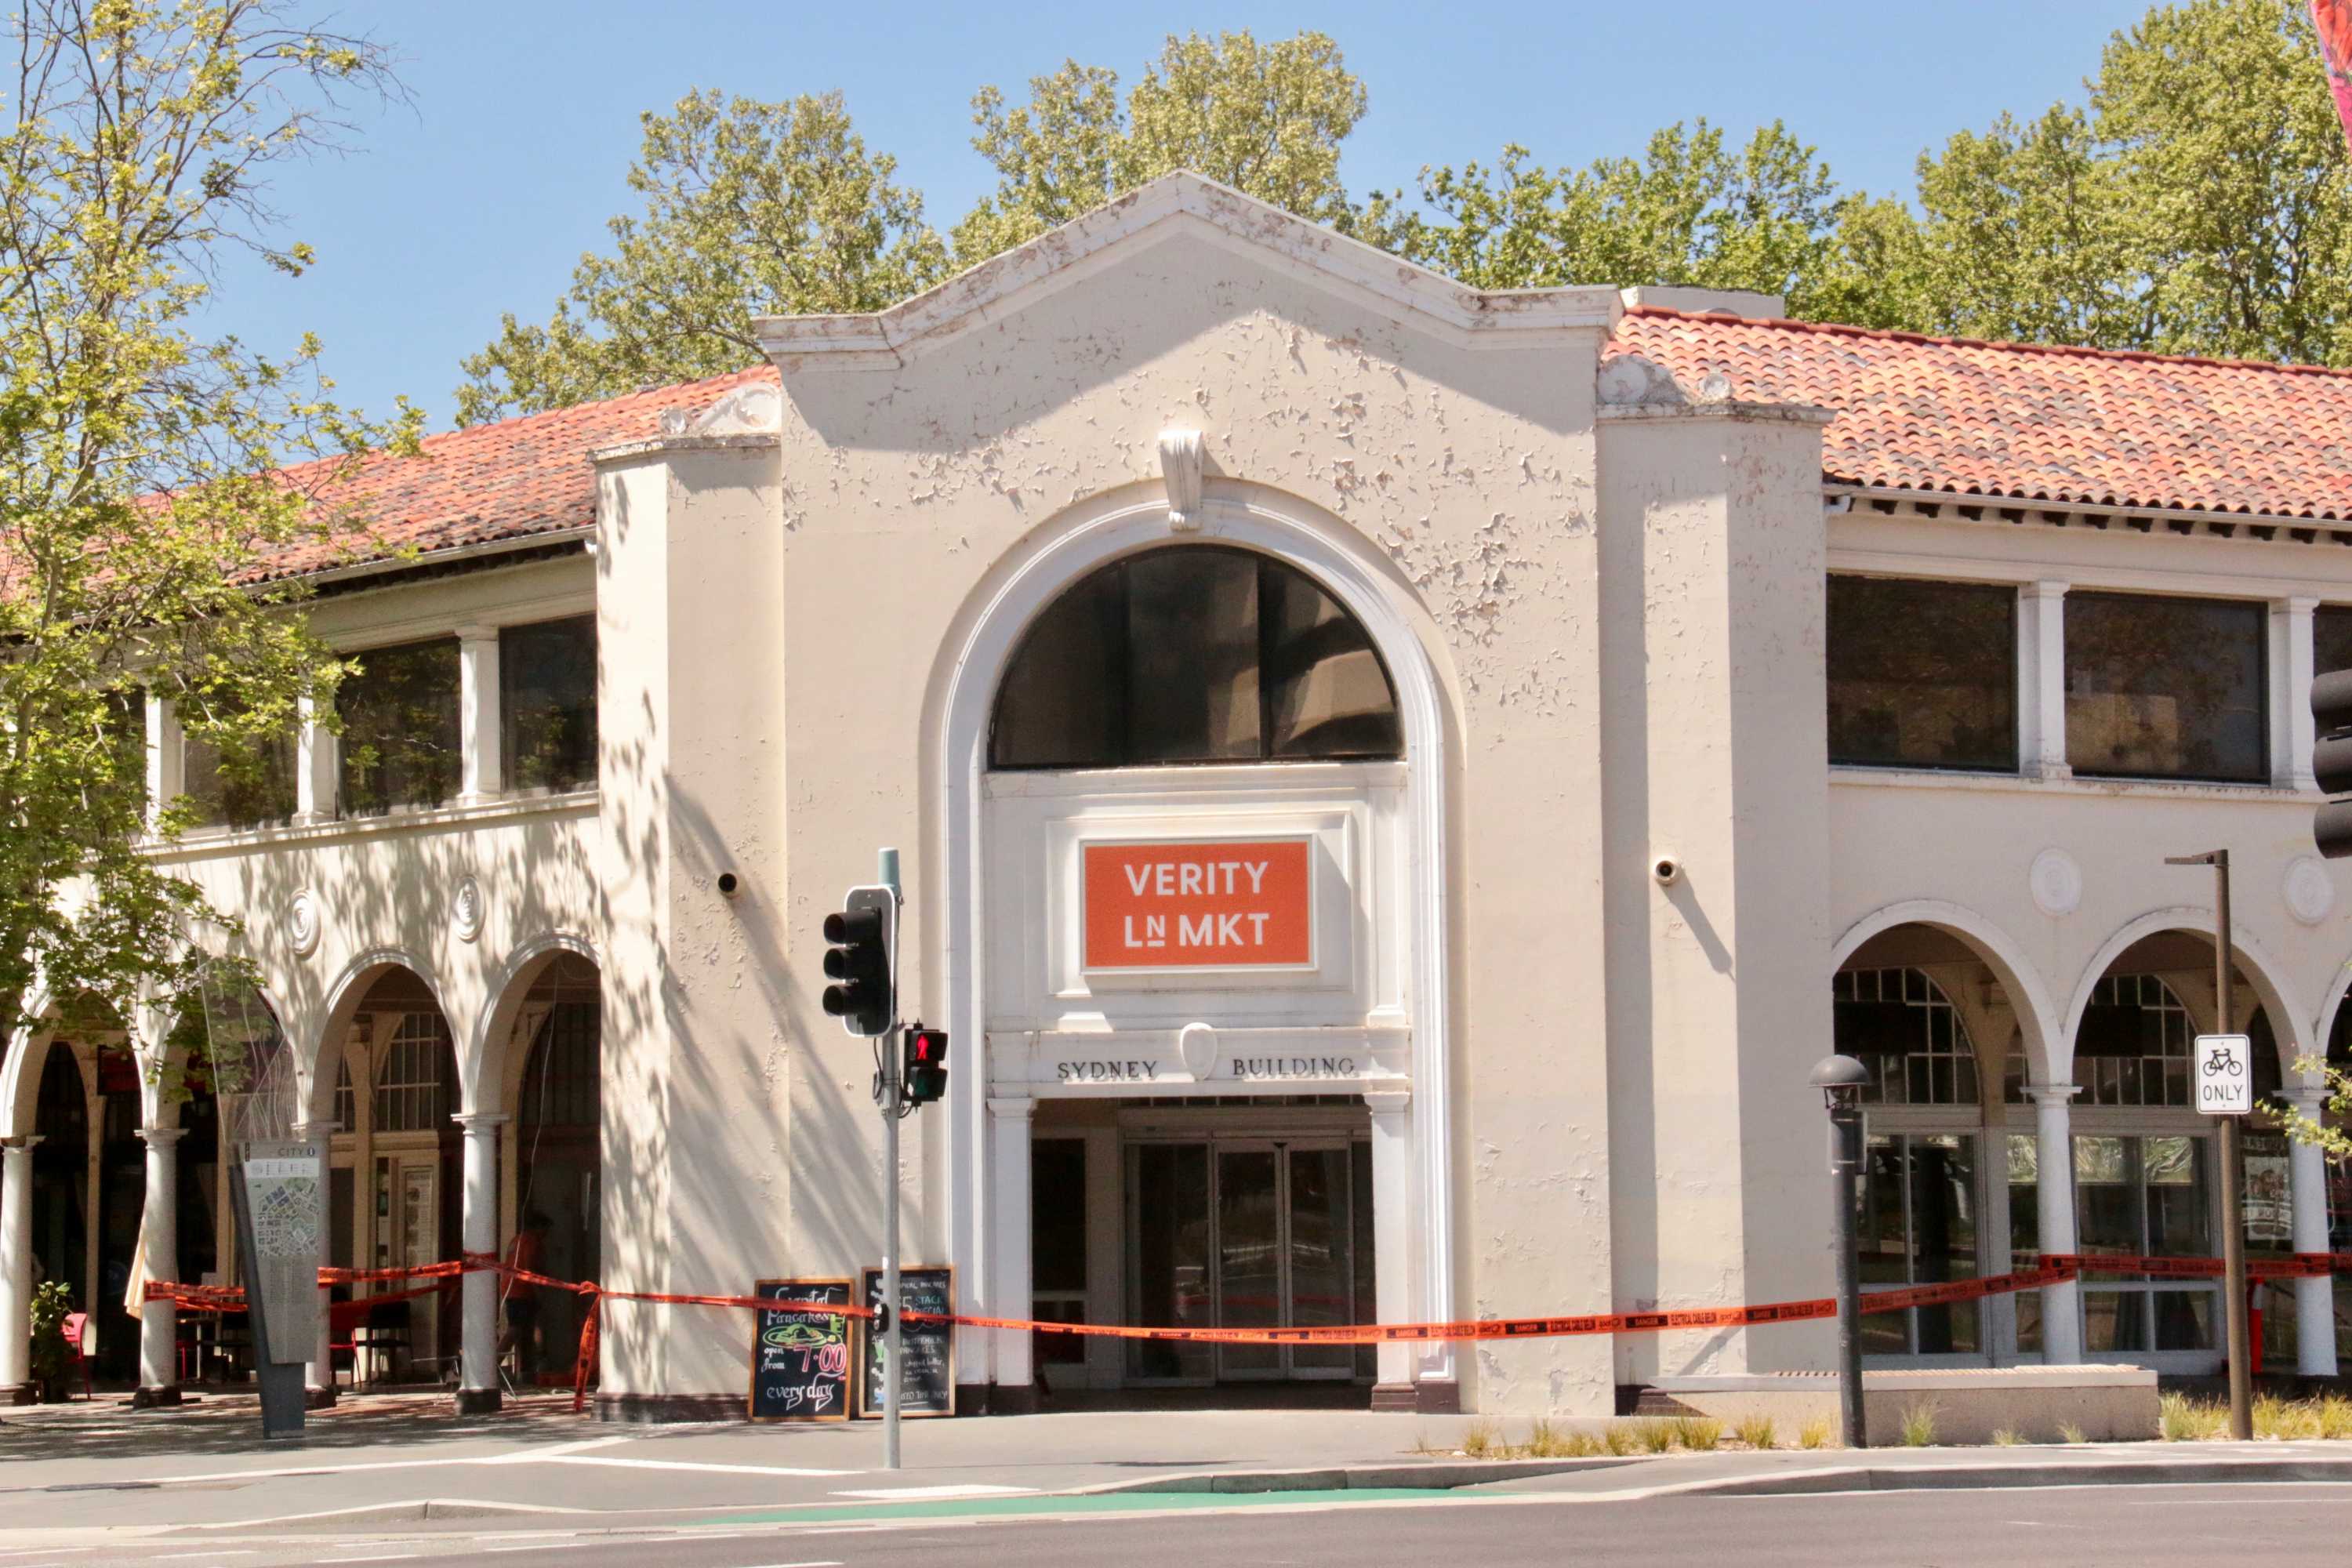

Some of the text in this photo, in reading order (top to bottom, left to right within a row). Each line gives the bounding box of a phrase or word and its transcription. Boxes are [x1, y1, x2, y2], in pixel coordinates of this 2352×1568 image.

[1123, 861, 1269, 895] VERITY
[1124, 913, 1269, 948] LN MKT
[1058, 1058, 1356, 1079] SYDNEY BUILDING
[2203, 1084, 2243, 1101] ONLY
[278, 1147, 303, 1156] CITY
[764, 1348, 784, 1359] open
[761, 1358, 786, 1374] from
[767, 1371, 845, 1412] every day
